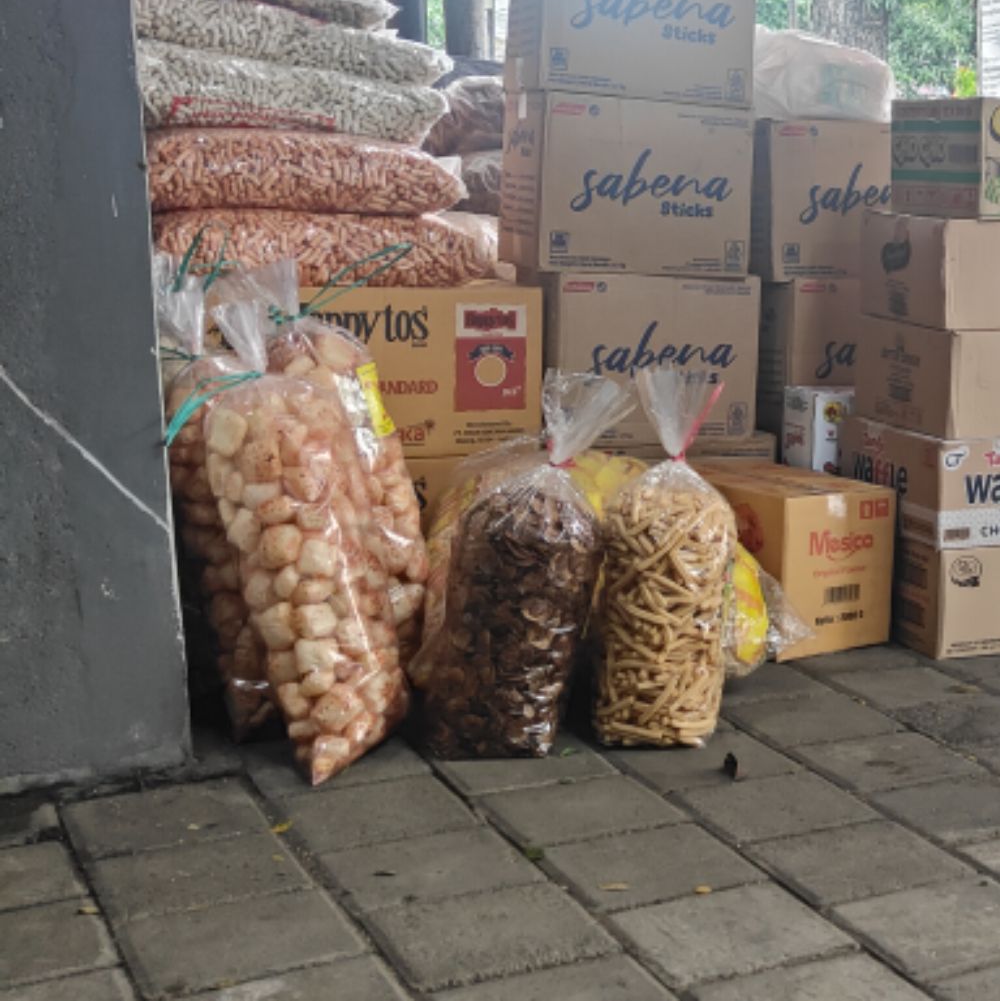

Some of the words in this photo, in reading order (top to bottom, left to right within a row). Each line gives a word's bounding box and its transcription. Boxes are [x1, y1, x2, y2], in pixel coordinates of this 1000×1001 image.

[661, 24, 717, 45] Sticks
[570, 149, 733, 212] sabena
[660, 201, 714, 217] Sticks
[586, 320, 738, 386] sabena
[379, 381, 438, 395] ANDARD
